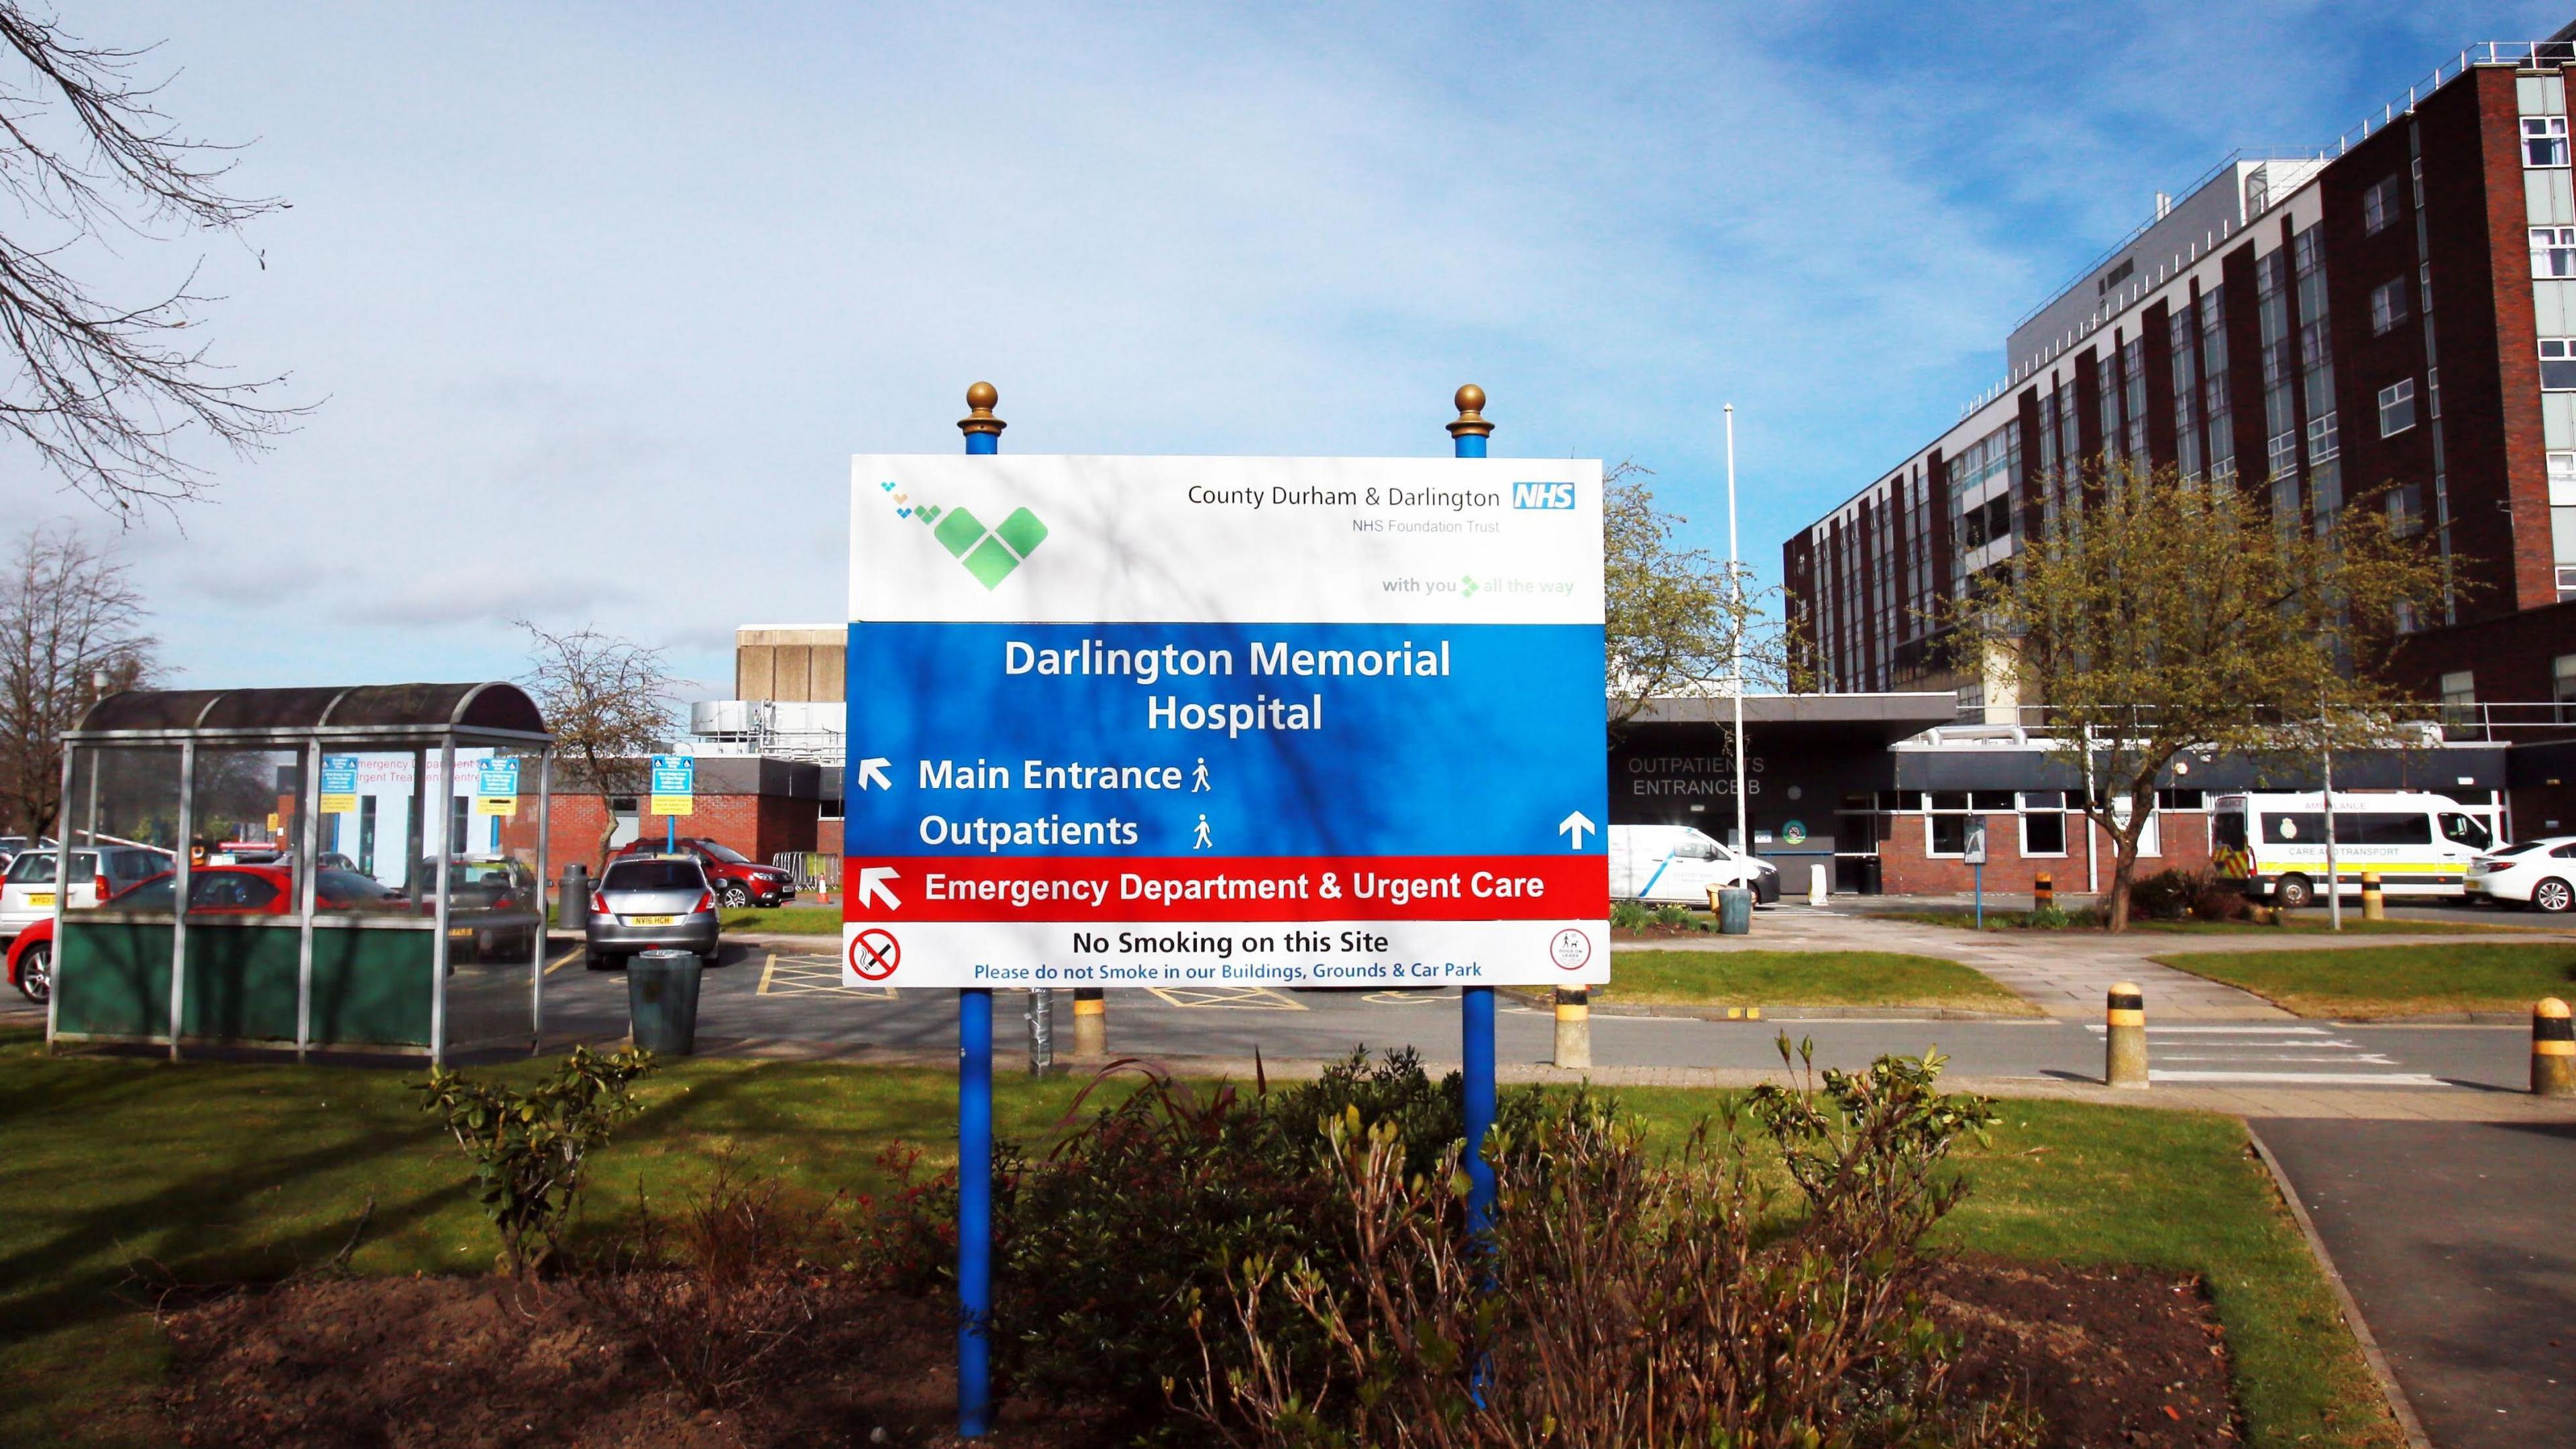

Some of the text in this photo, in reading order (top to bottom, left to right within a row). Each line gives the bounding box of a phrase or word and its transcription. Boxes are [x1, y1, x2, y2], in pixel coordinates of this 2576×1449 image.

[1189, 483, 1573, 511] County Durham & Darlington NHS
[1354, 520, 1499, 533] NHS Foundation Trust
[1383, 578, 1574, 596] with you all the way
[1006, 639, 1449, 684] Darlington Memorial
[1149, 694, 1321, 739] Hospital
[920, 759, 1181, 789] Main Entrance
[1628, 757, 1764, 772] OUTPATIENTS
[1633, 780, 1760, 794] ENTRANCE B
[920, 814, 1138, 852] Outpatients
[926, 871, 1544, 906] Emergency Department & Urgent Care
[1074, 931, 1388, 958] No Smoking on this Site
[975, 962, 1481, 981] Please do not Smoke in our Buildings, Grounds & Car Park
